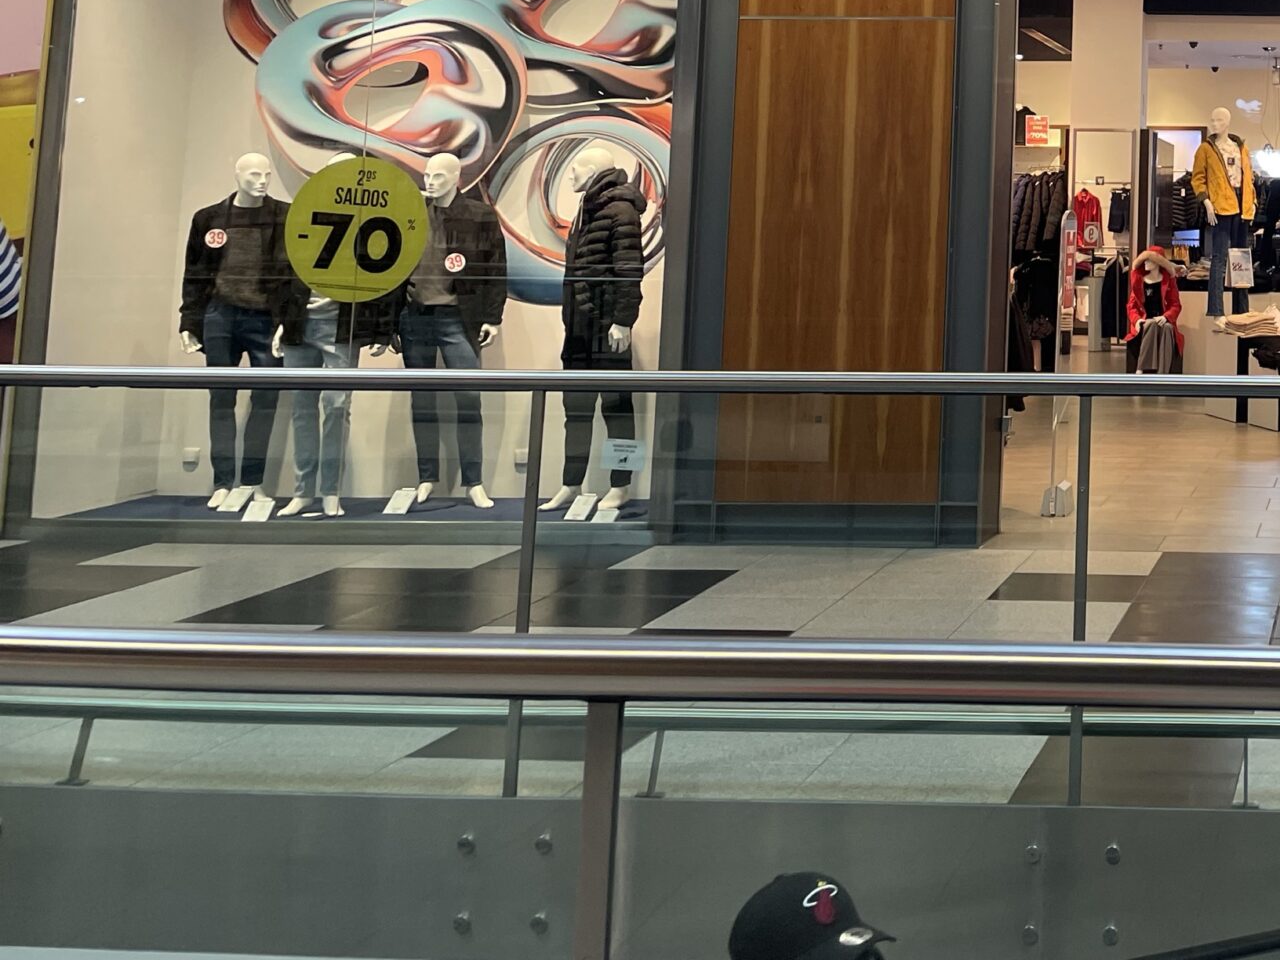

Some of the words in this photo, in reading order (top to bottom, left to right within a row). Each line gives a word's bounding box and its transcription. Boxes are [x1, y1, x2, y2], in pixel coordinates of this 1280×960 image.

[334, 186, 389, 208] SALDOS
[208, 231, 224, 245] 39
[447, 254, 463, 270] 39
